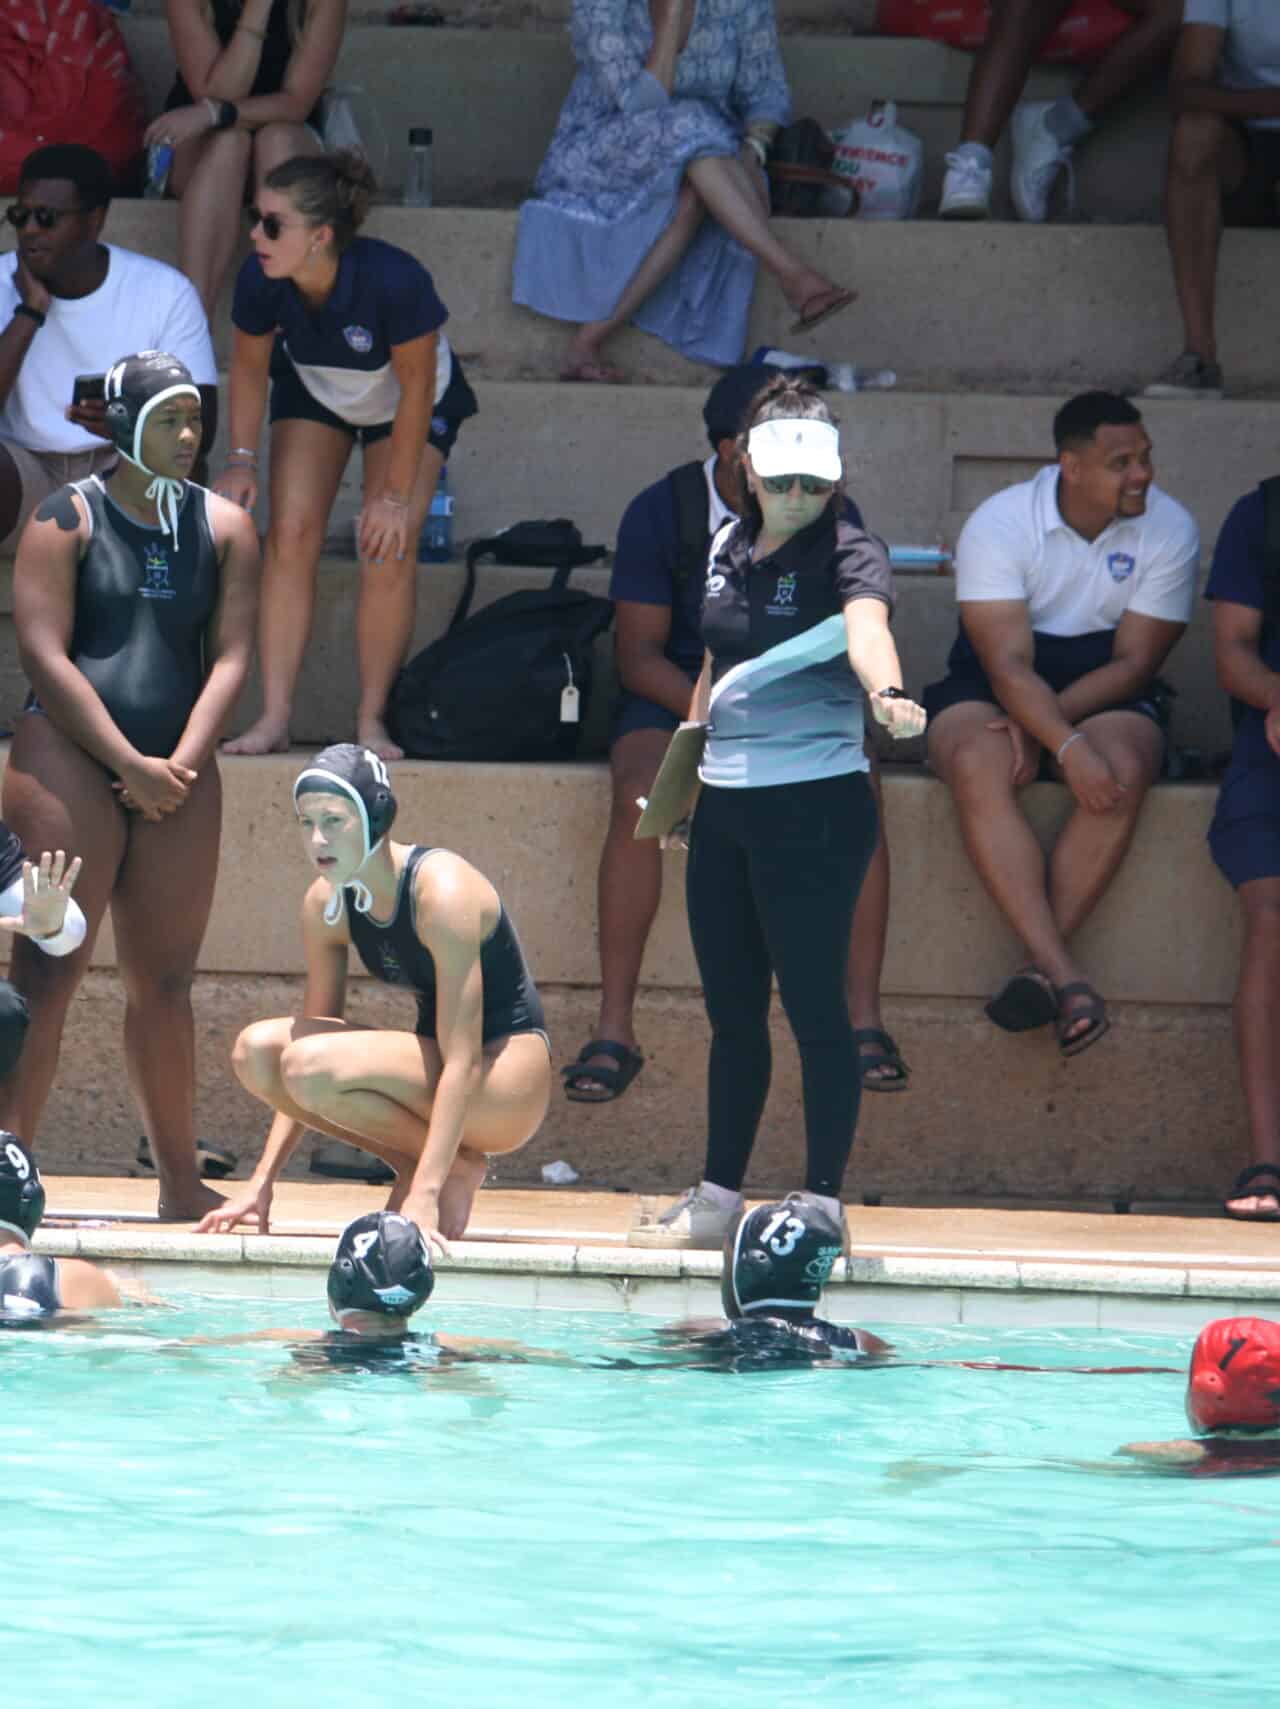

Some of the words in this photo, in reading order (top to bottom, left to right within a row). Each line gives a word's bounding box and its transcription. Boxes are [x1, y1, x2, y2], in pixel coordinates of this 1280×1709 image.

[5, 1143, 30, 1180] 9
[353, 1230, 379, 1259] 4
[759, 1210, 806, 1256] 13
